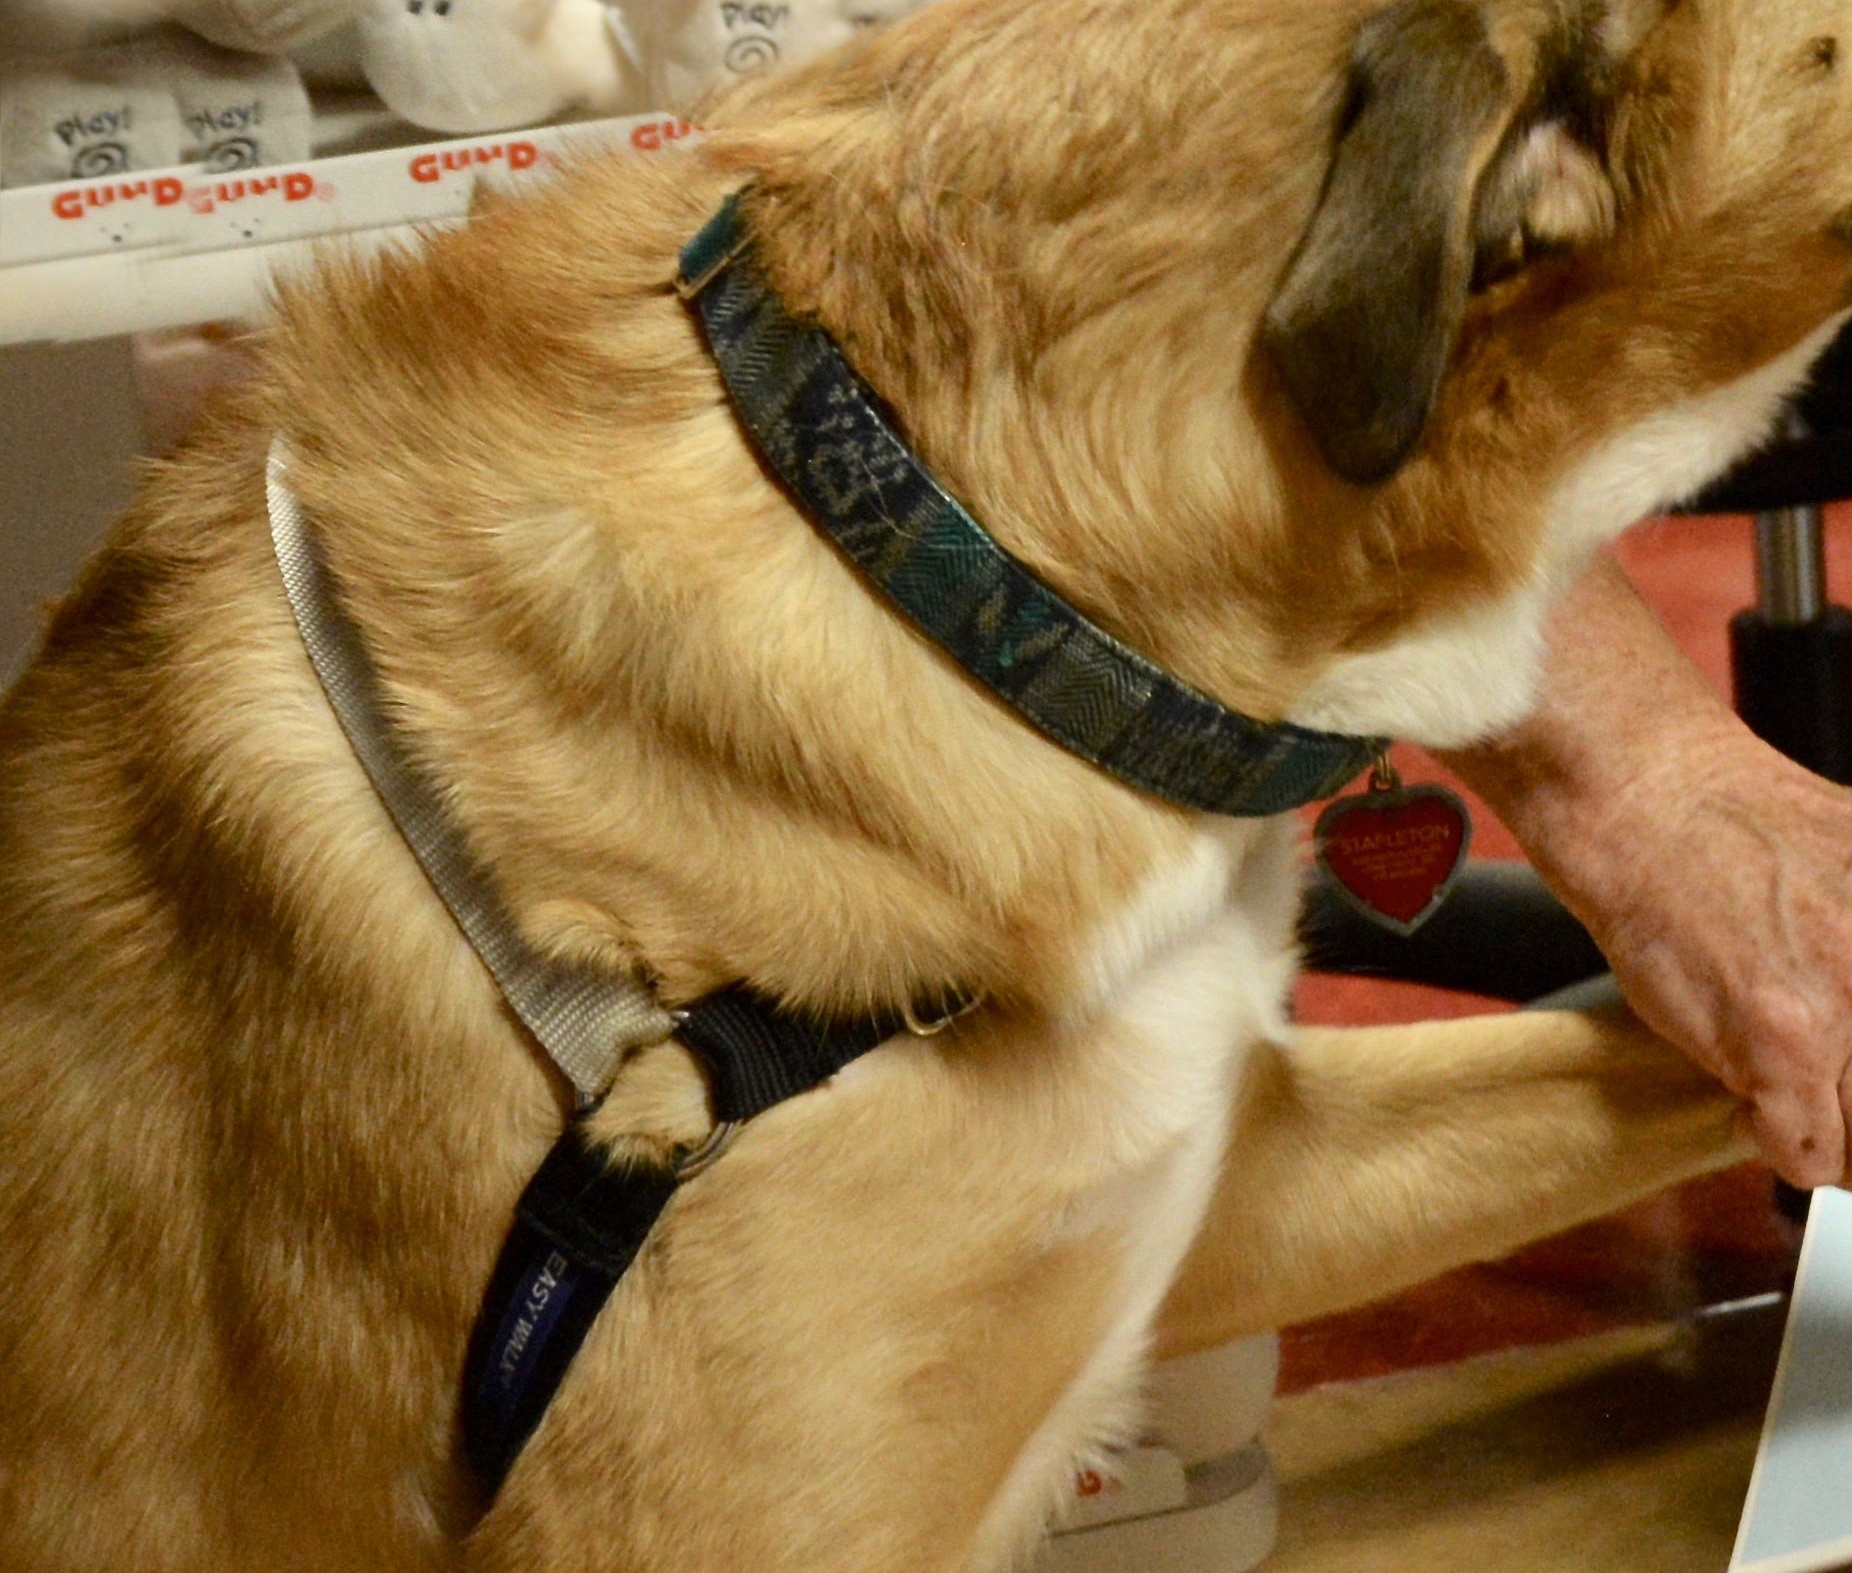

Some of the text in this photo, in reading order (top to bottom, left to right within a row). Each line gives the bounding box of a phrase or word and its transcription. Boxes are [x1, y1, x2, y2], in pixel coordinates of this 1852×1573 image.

[52, 177, 183, 220] GUND
[409, 140, 537, 184] GUND
[630, 120, 706, 154] GU
[525, 1250, 568, 1322] EASY
